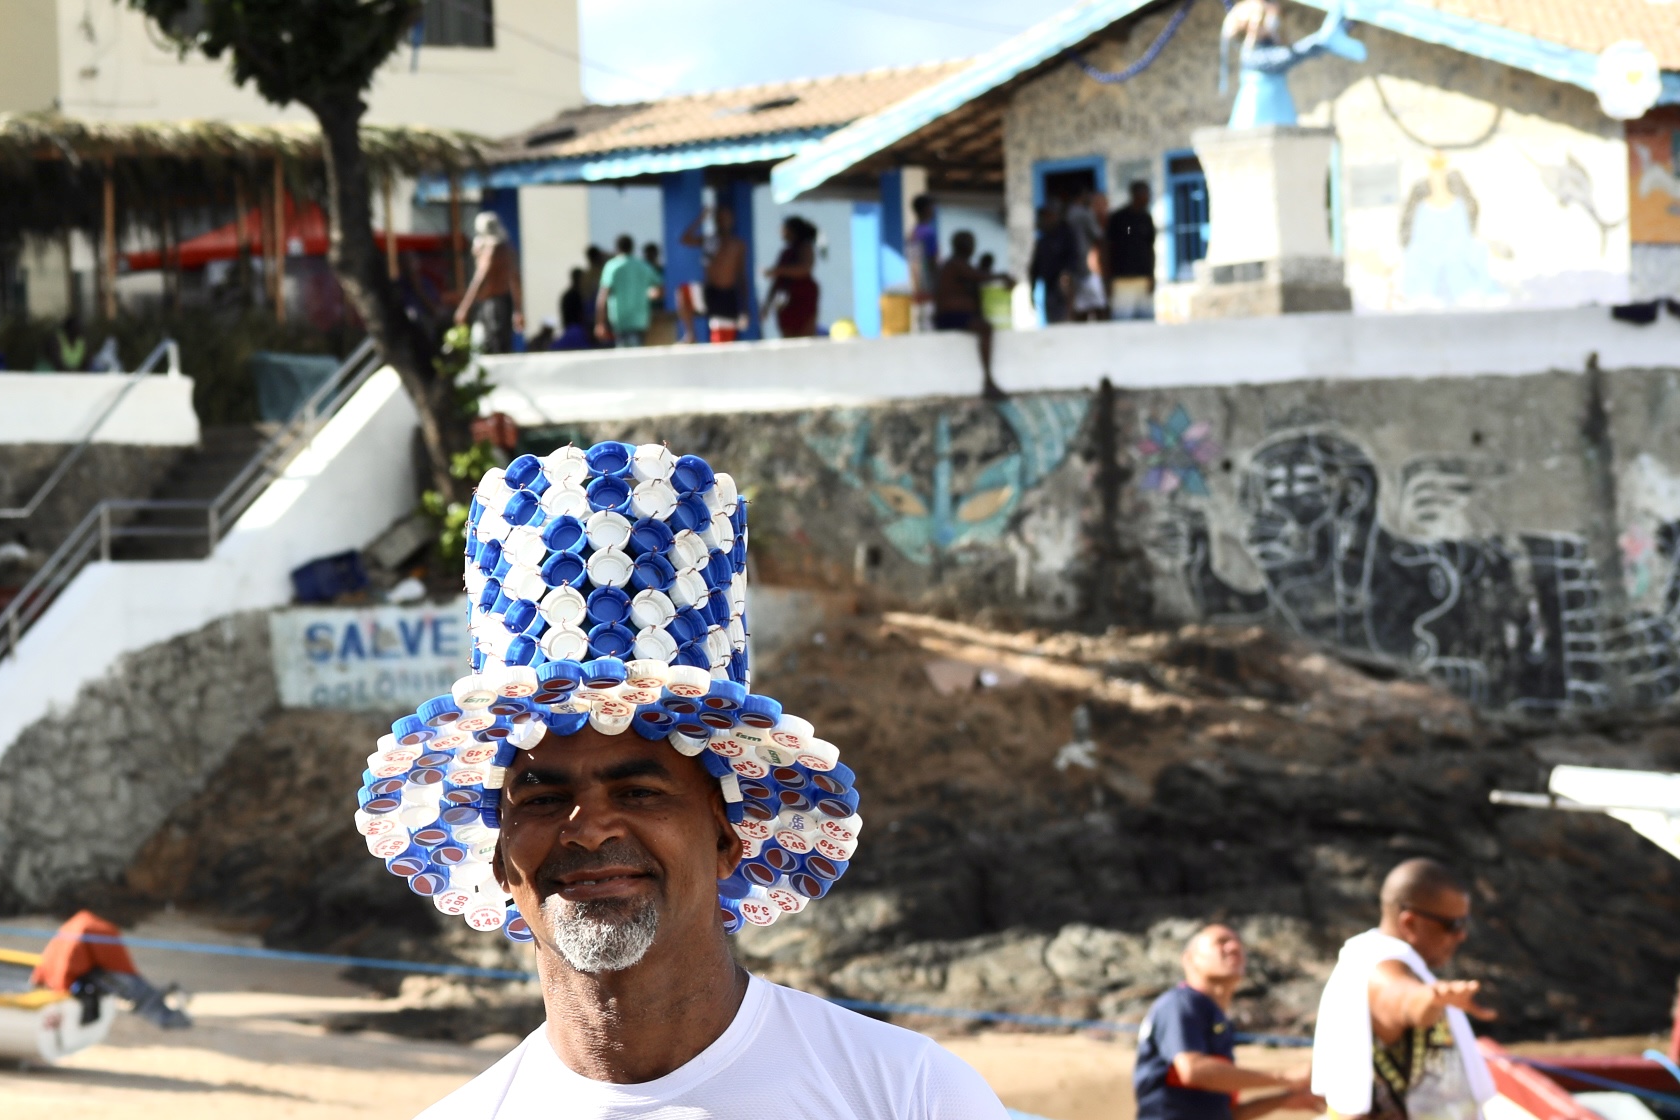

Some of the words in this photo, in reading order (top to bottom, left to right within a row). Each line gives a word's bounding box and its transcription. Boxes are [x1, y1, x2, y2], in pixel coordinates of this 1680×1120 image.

[304, 614, 460, 662] SALVE
[711, 740, 739, 751] 3,49
[825, 821, 853, 839] 3,49
[780, 839, 807, 851] 3,49
[819, 839, 847, 857] 3,49
[743, 903, 770, 916] 3,49
[769, 892, 793, 912] 3,49
[472, 917, 501, 928] 3,49
